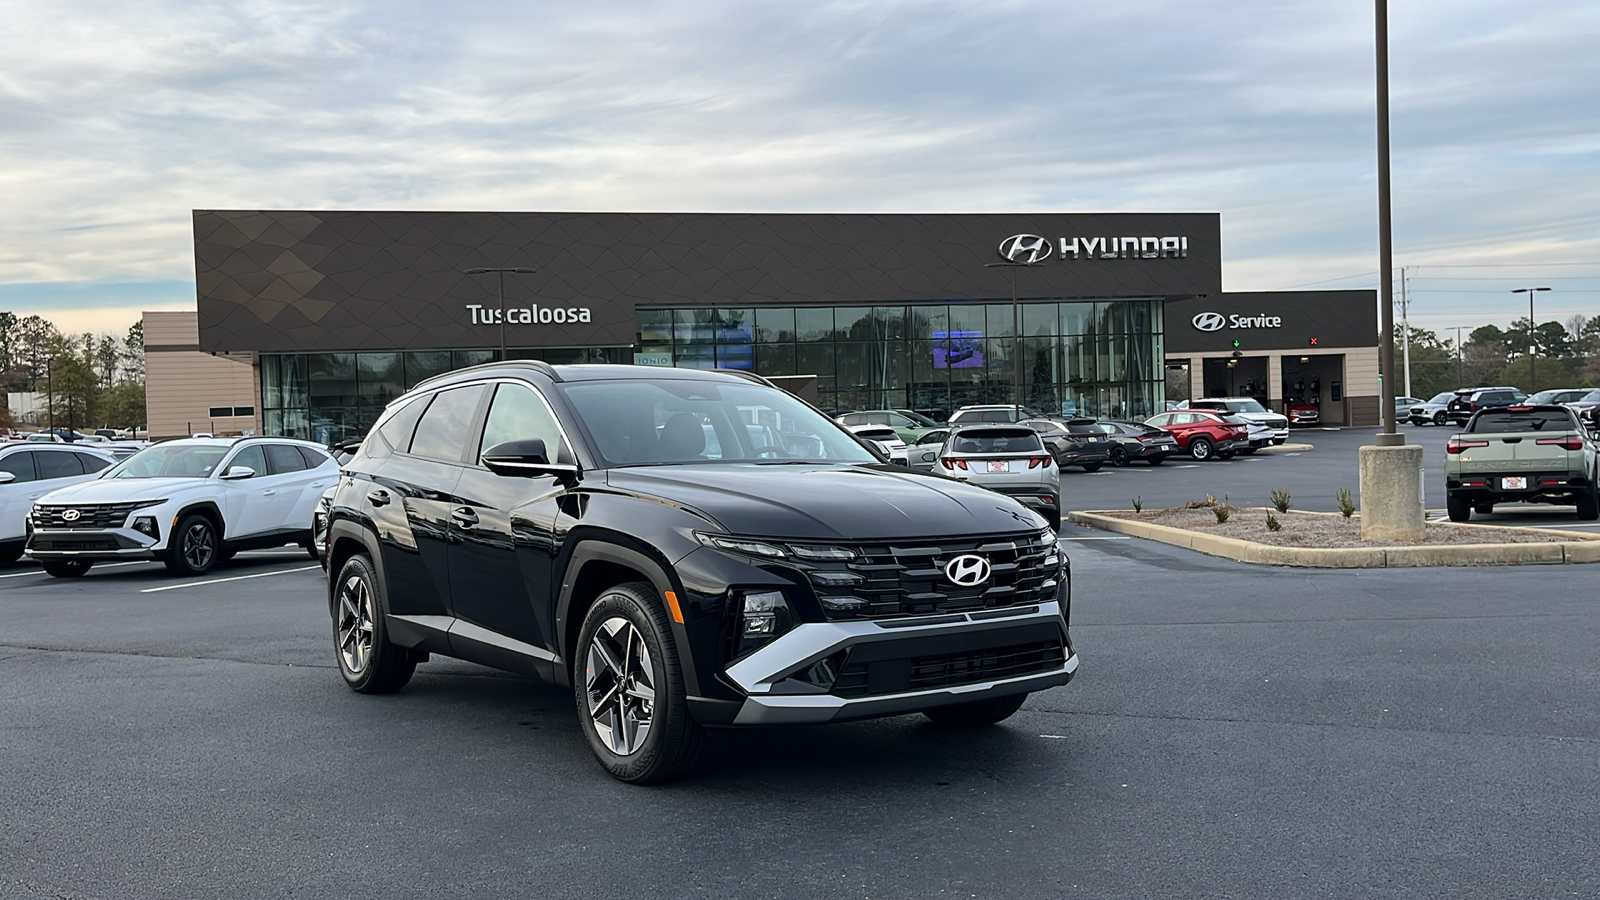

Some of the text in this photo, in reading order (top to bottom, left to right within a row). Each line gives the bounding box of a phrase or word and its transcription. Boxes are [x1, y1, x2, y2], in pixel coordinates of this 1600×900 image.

[1059, 236, 1188, 260] HYUNDAI
[466, 303, 591, 325] Tuscaloosa
[1229, 312, 1282, 329] Service
